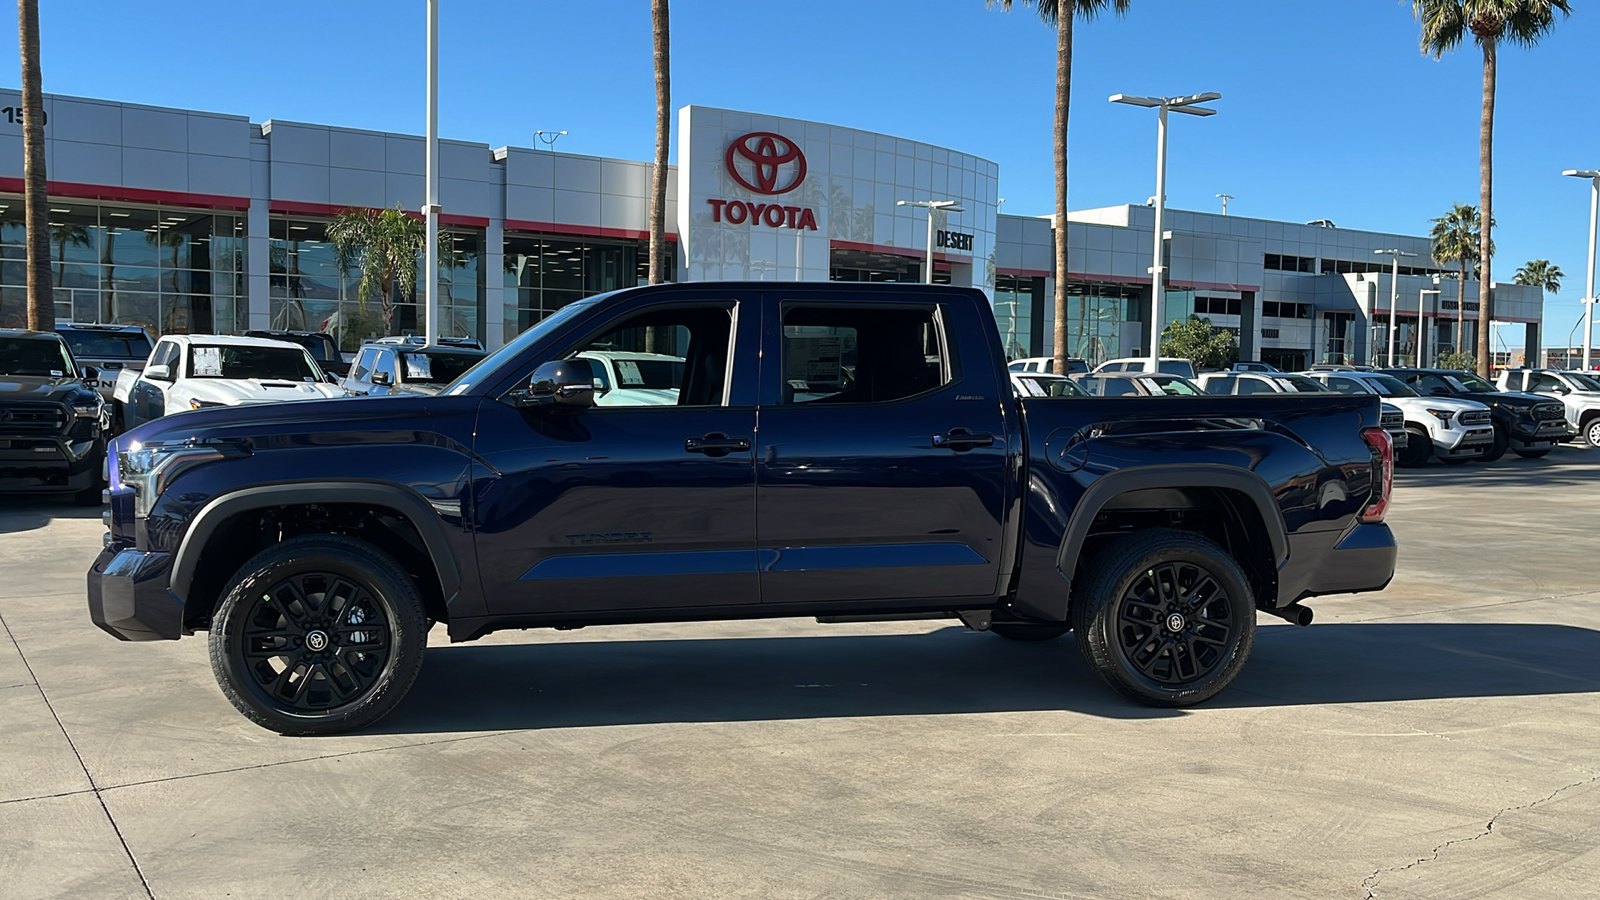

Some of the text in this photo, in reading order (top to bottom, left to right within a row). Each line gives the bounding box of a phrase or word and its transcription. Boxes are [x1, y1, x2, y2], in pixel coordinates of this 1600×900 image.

[707, 199, 818, 231] TOYOTA
[936, 229, 974, 251] DESERT
[565, 531, 653, 546] TUNDRA
